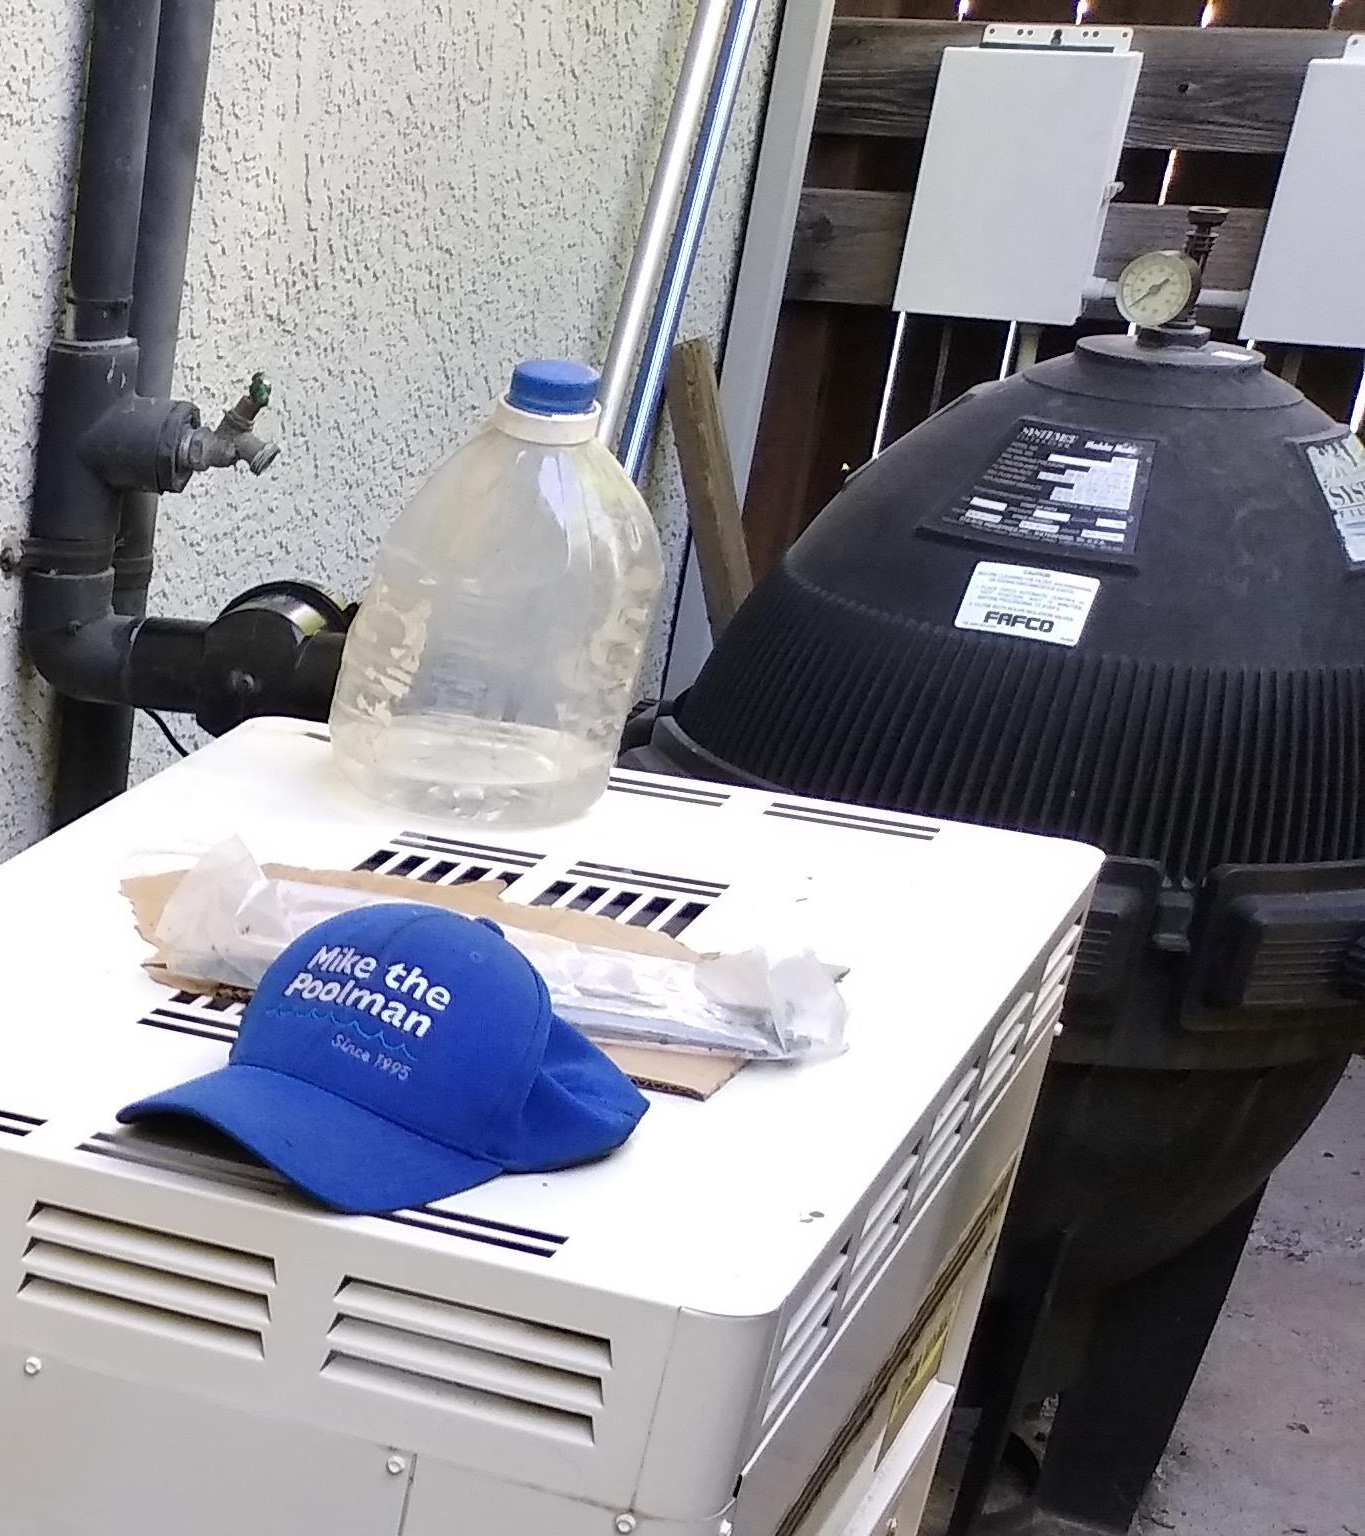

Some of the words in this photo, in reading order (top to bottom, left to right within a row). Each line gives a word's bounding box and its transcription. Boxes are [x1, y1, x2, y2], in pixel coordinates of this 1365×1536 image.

[983, 610, 1055, 634] FAFCO
[283, 972, 432, 1038] Poolman
[307, 945, 377, 979] Mike
[385, 962, 451, 1012] the
[331, 1033, 371, 1062] Since
[373, 1052, 413, 1082] 1995
